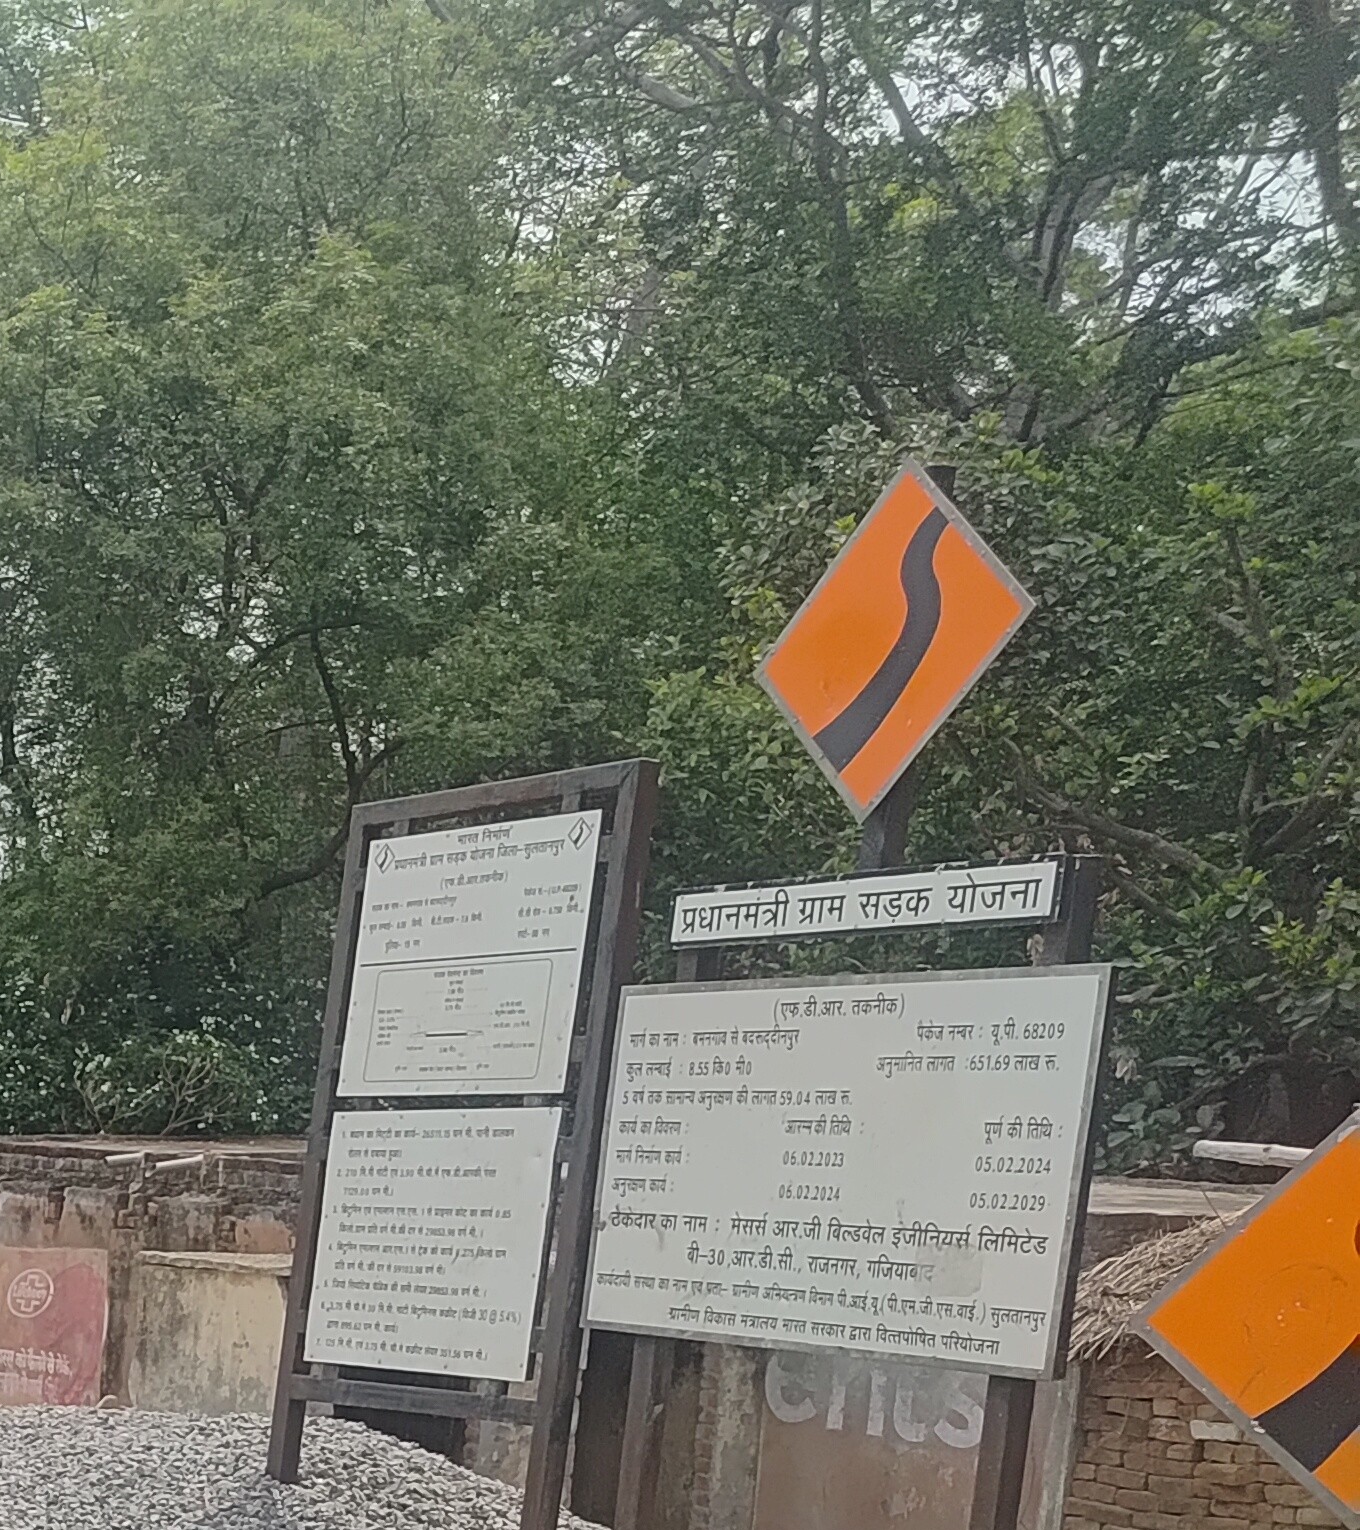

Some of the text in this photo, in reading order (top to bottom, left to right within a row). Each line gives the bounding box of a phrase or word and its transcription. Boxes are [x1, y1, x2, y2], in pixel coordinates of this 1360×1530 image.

[680, 873, 1043, 934] प्रधानमंत्री ग्राम सड़क योजना
[852, 992, 905, 1019] तकनीक)
[649, 1032, 660, 1047] का
[730, 1026, 739, 1045] से
[917, 1019, 944, 1041] पैकेज
[1023, 1022, 1065, 1040] 68209
[626, 1061, 643, 1082] कुल
[689, 1061, 709, 1076] 8.55
[876, 1051, 923, 1079] अनुमानित
[926, 1055, 955, 1071] लागत
[1014, 1055, 1040, 1071] लाख
[622, 1090, 630, 1105] 5
[633, 1085, 646, 1104] वर्ष
[648, 1090, 663, 1104] तक
[736, 1084, 748, 1105] की
[751, 1090, 778, 1105] लागत
[779, 1090, 810, 1106] 59.04
[815, 1090, 837, 1105] लाख
[619, 1115, 638, 1135] कार्य
[641, 1120, 651, 1135] का
[814, 1114, 827, 1136] की
[829, 1114, 852, 1136] तिथि
[984, 1115, 1004, 1144] पूर्ण
[1007, 1115, 1022, 1139] की
[1027, 1116, 1053, 1139] तिथि
[664, 1145, 682, 1165] कार्य
[783, 1150, 844, 1168] 06.02.2023
[975, 1156, 1051, 1174] 05.02.2024
[649, 1173, 668, 1193] कार्य
[778, 1184, 840, 1201] 06.02.2024
[969, 1192, 1045, 1212] 05.02.2029
[610, 1204, 656, 1229] ठेकेदार
[660, 1213, 678, 1231] का
[682, 1215, 708, 1232] नाम
[730, 1211, 769, 1237] मेसर्स
[772, 1215, 821, 1241] आर.जी
[978, 1225, 1049, 1255] लिमिटेड
[867, 1254, 936, 1282] गजियाबाद
[658, 1277, 670, 1291] का
[672, 1279, 688, 1292] नाम
[731, 1279, 760, 1298] ग्रामीण
[990, 1306, 1047, 1333] सुलतानपुर
[668, 1303, 700, 1324] ग्रामीण
[703, 1306, 737, 1327] विकास
[782, 1316, 807, 1334] भारत
[811, 1321, 846, 1340] सरकार
[849, 1325, 871, 1342] द्वारा
[941, 1330, 1000, 1356] परियोजना
